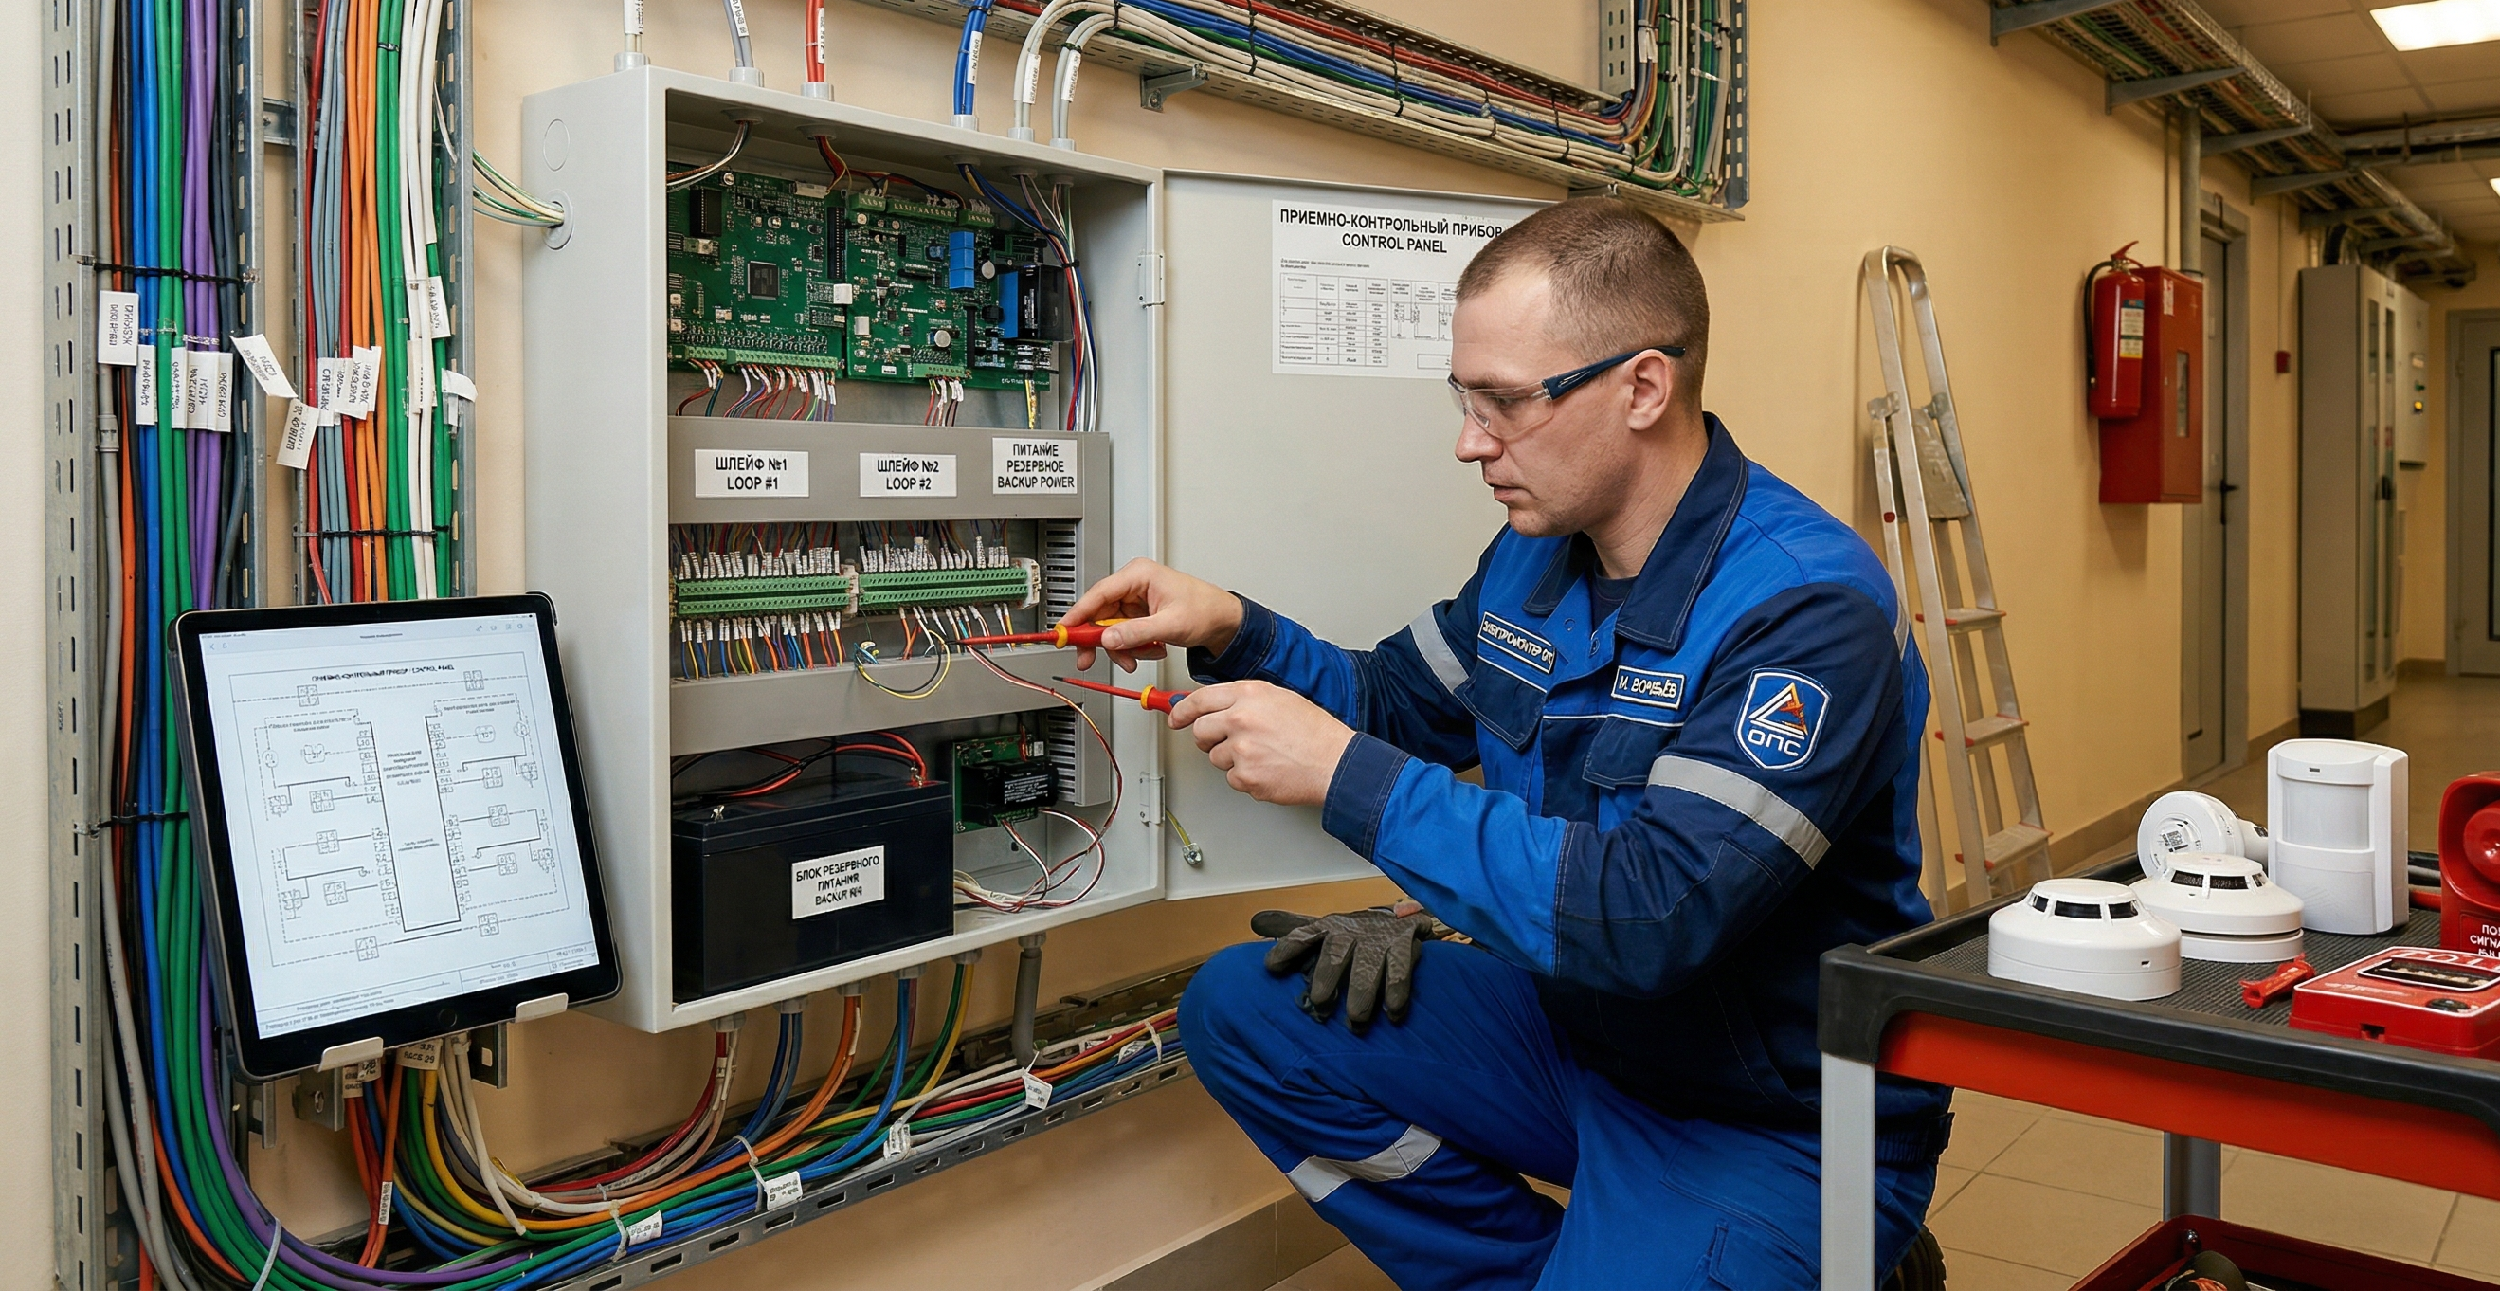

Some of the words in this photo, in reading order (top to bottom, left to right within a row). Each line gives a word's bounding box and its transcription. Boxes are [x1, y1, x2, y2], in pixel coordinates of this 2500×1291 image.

[1280, 208, 1449, 235] ПРИЕМНО-КОНТРОЛЬНЫЙ
[1453, 222, 1503, 239] ПРИБОР
[1342, 233, 1405, 251] CONTROL
[1407, 238, 1447, 254] PANEL
[715, 454, 765, 471] ШЛЕЙФ
[877, 458, 919, 473] ШЛЕЙФ
[1006, 460, 1065, 473] РЕЗЕРВНОЕ
[727, 476, 762, 490] LOOP
[765, 476, 779, 490] #1
[886, 477, 917, 490] LOOP
[918, 477, 932, 490] #2
[997, 476, 1039, 488] BACKUP
[1747, 729, 1802, 756] ОПС
[796, 867, 822, 883] БЛОК
[823, 855, 880, 876] РЕЗЕРВНОГО
